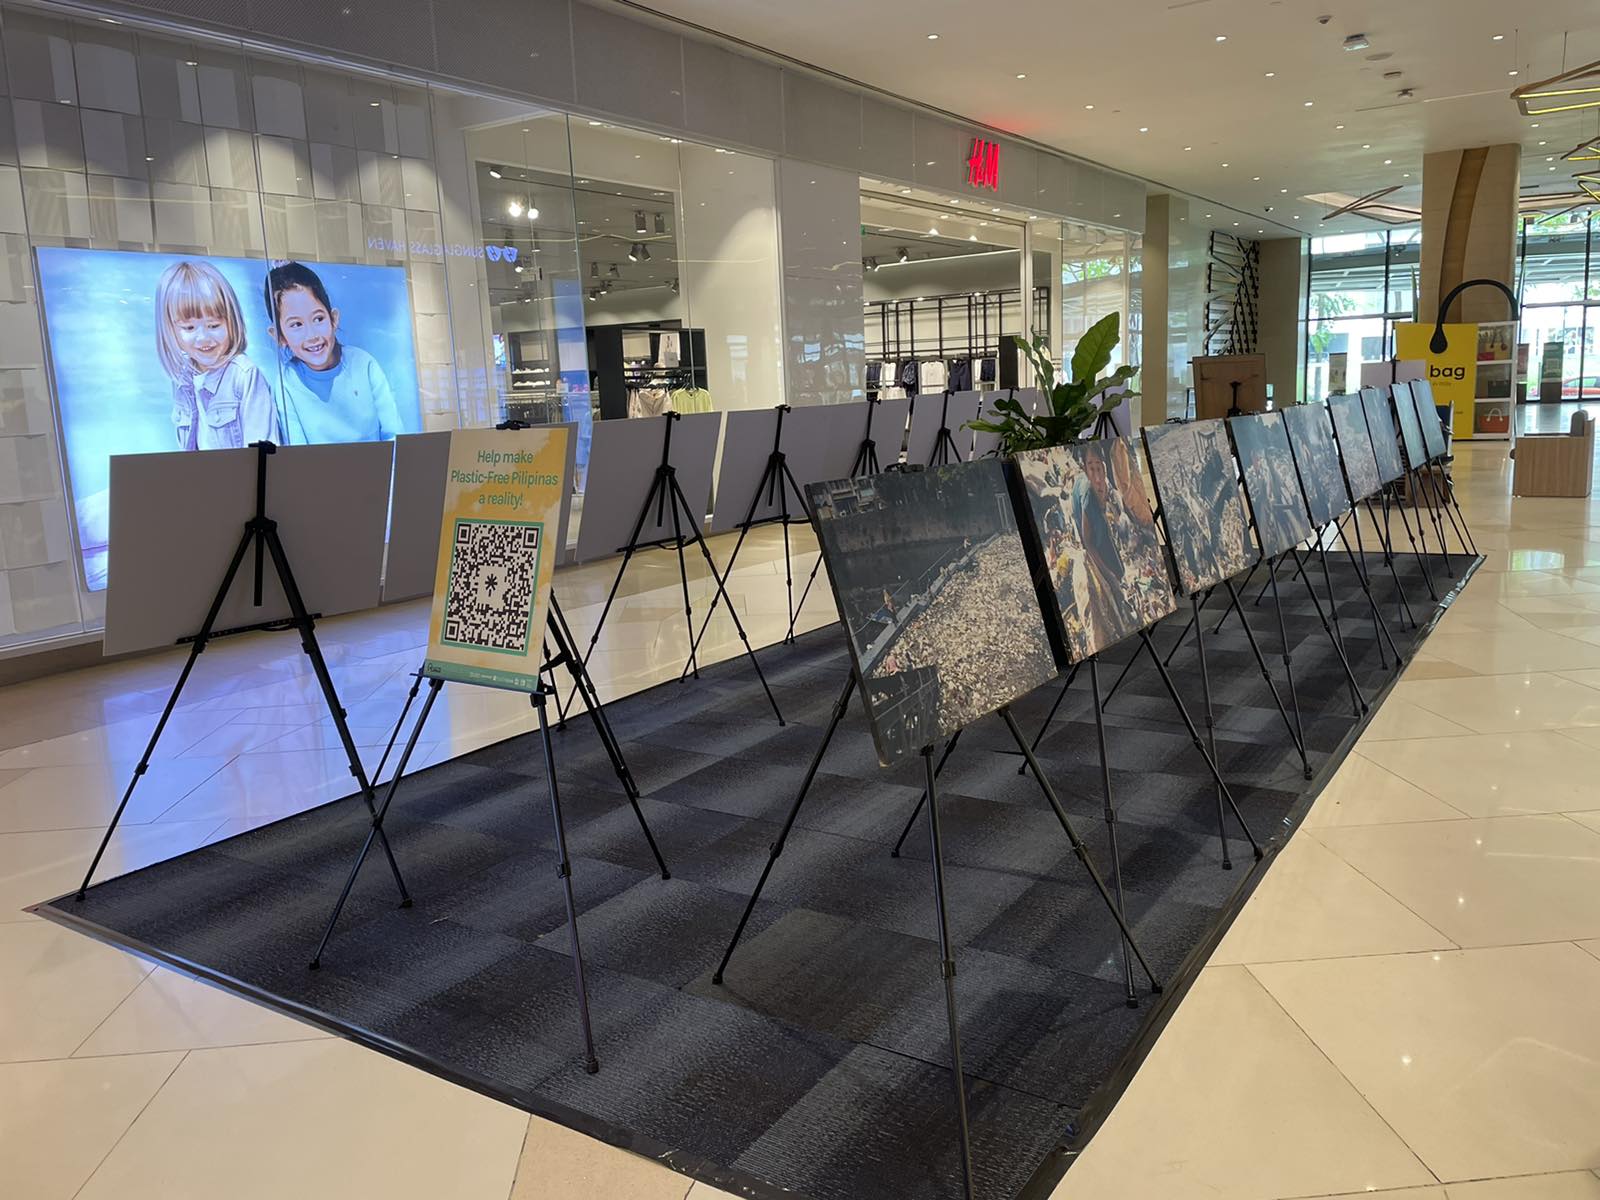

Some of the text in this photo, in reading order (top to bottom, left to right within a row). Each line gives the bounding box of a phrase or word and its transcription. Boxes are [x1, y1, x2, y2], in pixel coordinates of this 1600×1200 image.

[968, 136, 1000, 192] H&M
[1430, 364, 1465, 380] bag
[477, 450, 534, 467] Help make
[450, 470, 558, 488] Plastic-Free Pilipinas
[478, 491, 524, 511] a reality!
